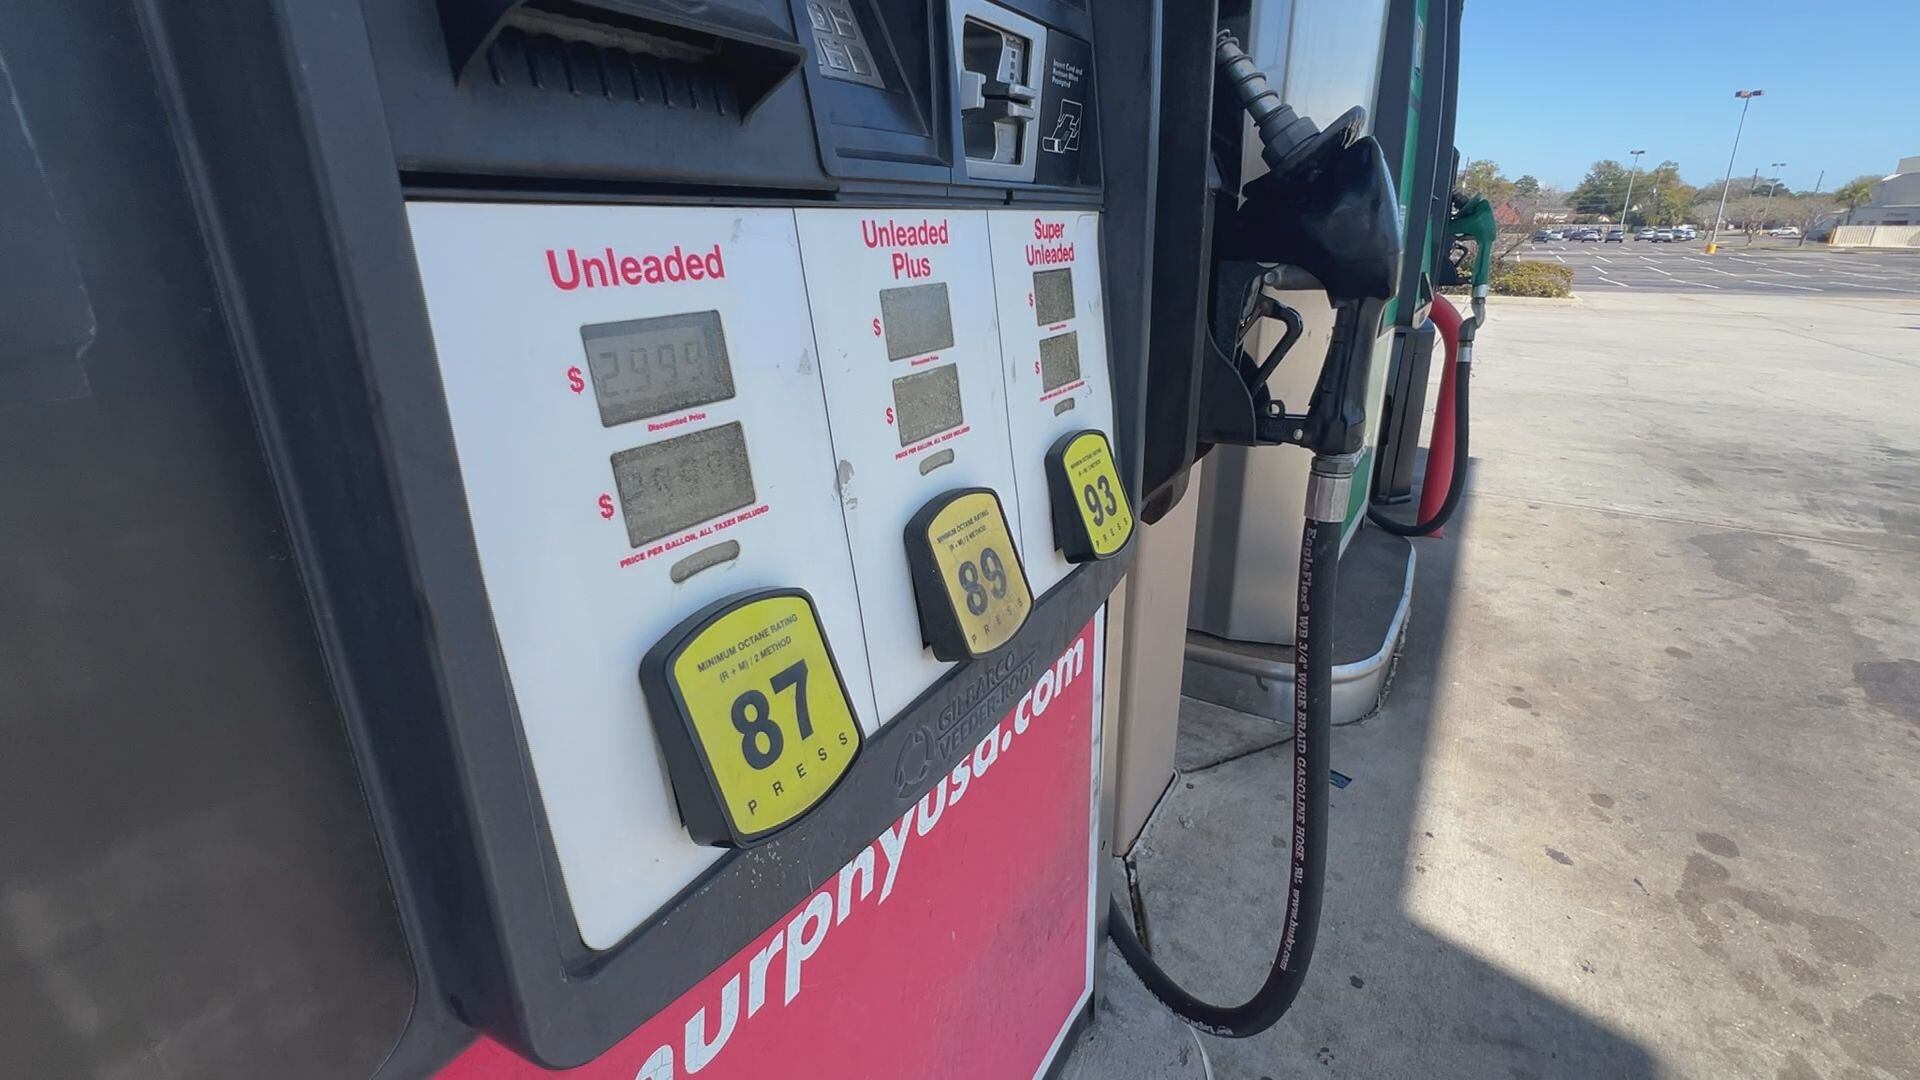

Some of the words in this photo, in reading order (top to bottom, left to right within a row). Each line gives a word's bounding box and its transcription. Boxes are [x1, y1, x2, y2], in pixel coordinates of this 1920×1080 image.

[861, 219, 949, 249] Unleaded
[1034, 218, 1065, 243] Super
[545, 244, 726, 291] Unleaded
[892, 253, 931, 280] Plus
[1025, 243, 1075, 266] Unleaded
[873, 318, 882, 337] $
[567, 366, 585, 395] $
[648, 416, 687, 432] Discounted
[689, 413, 707, 422] Price
[886, 407, 894, 425] $
[598, 493, 615, 520] $
[1084, 475, 1117, 527] 93
[620, 553, 646, 568] PRICE
[647, 546, 663, 557] PER
[665, 534, 698, 551] GALLON,
[700, 527, 713, 537] ALL
[714, 518, 737, 531] TAXES
[737, 505, 770, 522] INCLUDED
[956, 517, 974, 532] OCTANE
[973, 509, 989, 521] RATING
[958, 547, 1007, 616] 89
[971, 597, 1023, 645] PRESS
[1299, 616, 1309, 639] WB
[697, 646, 736, 672] MINIMUM
[738, 628, 769, 651] OCTANE
[771, 613, 798, 634] RATING
[719, 670, 728, 683] (R
[738, 661, 749, 672] M)
[754, 654, 760, 663] 2
[760, 636, 791, 658] METHOD
[1298, 642, 1309, 670] 3/4"
[937, 650, 1015, 732] GILBARCO
[1297, 672, 1308, 708] WIRE
[731, 659, 814, 770] 87
[938, 658, 1036, 760] VEEDER-ROOT
[1297, 709, 1307, 754] BRAID
[748, 732, 848, 815] PRESS
[1296, 756, 1307, 826] GASOLINE
[1295, 825, 1305, 861] HOSE
